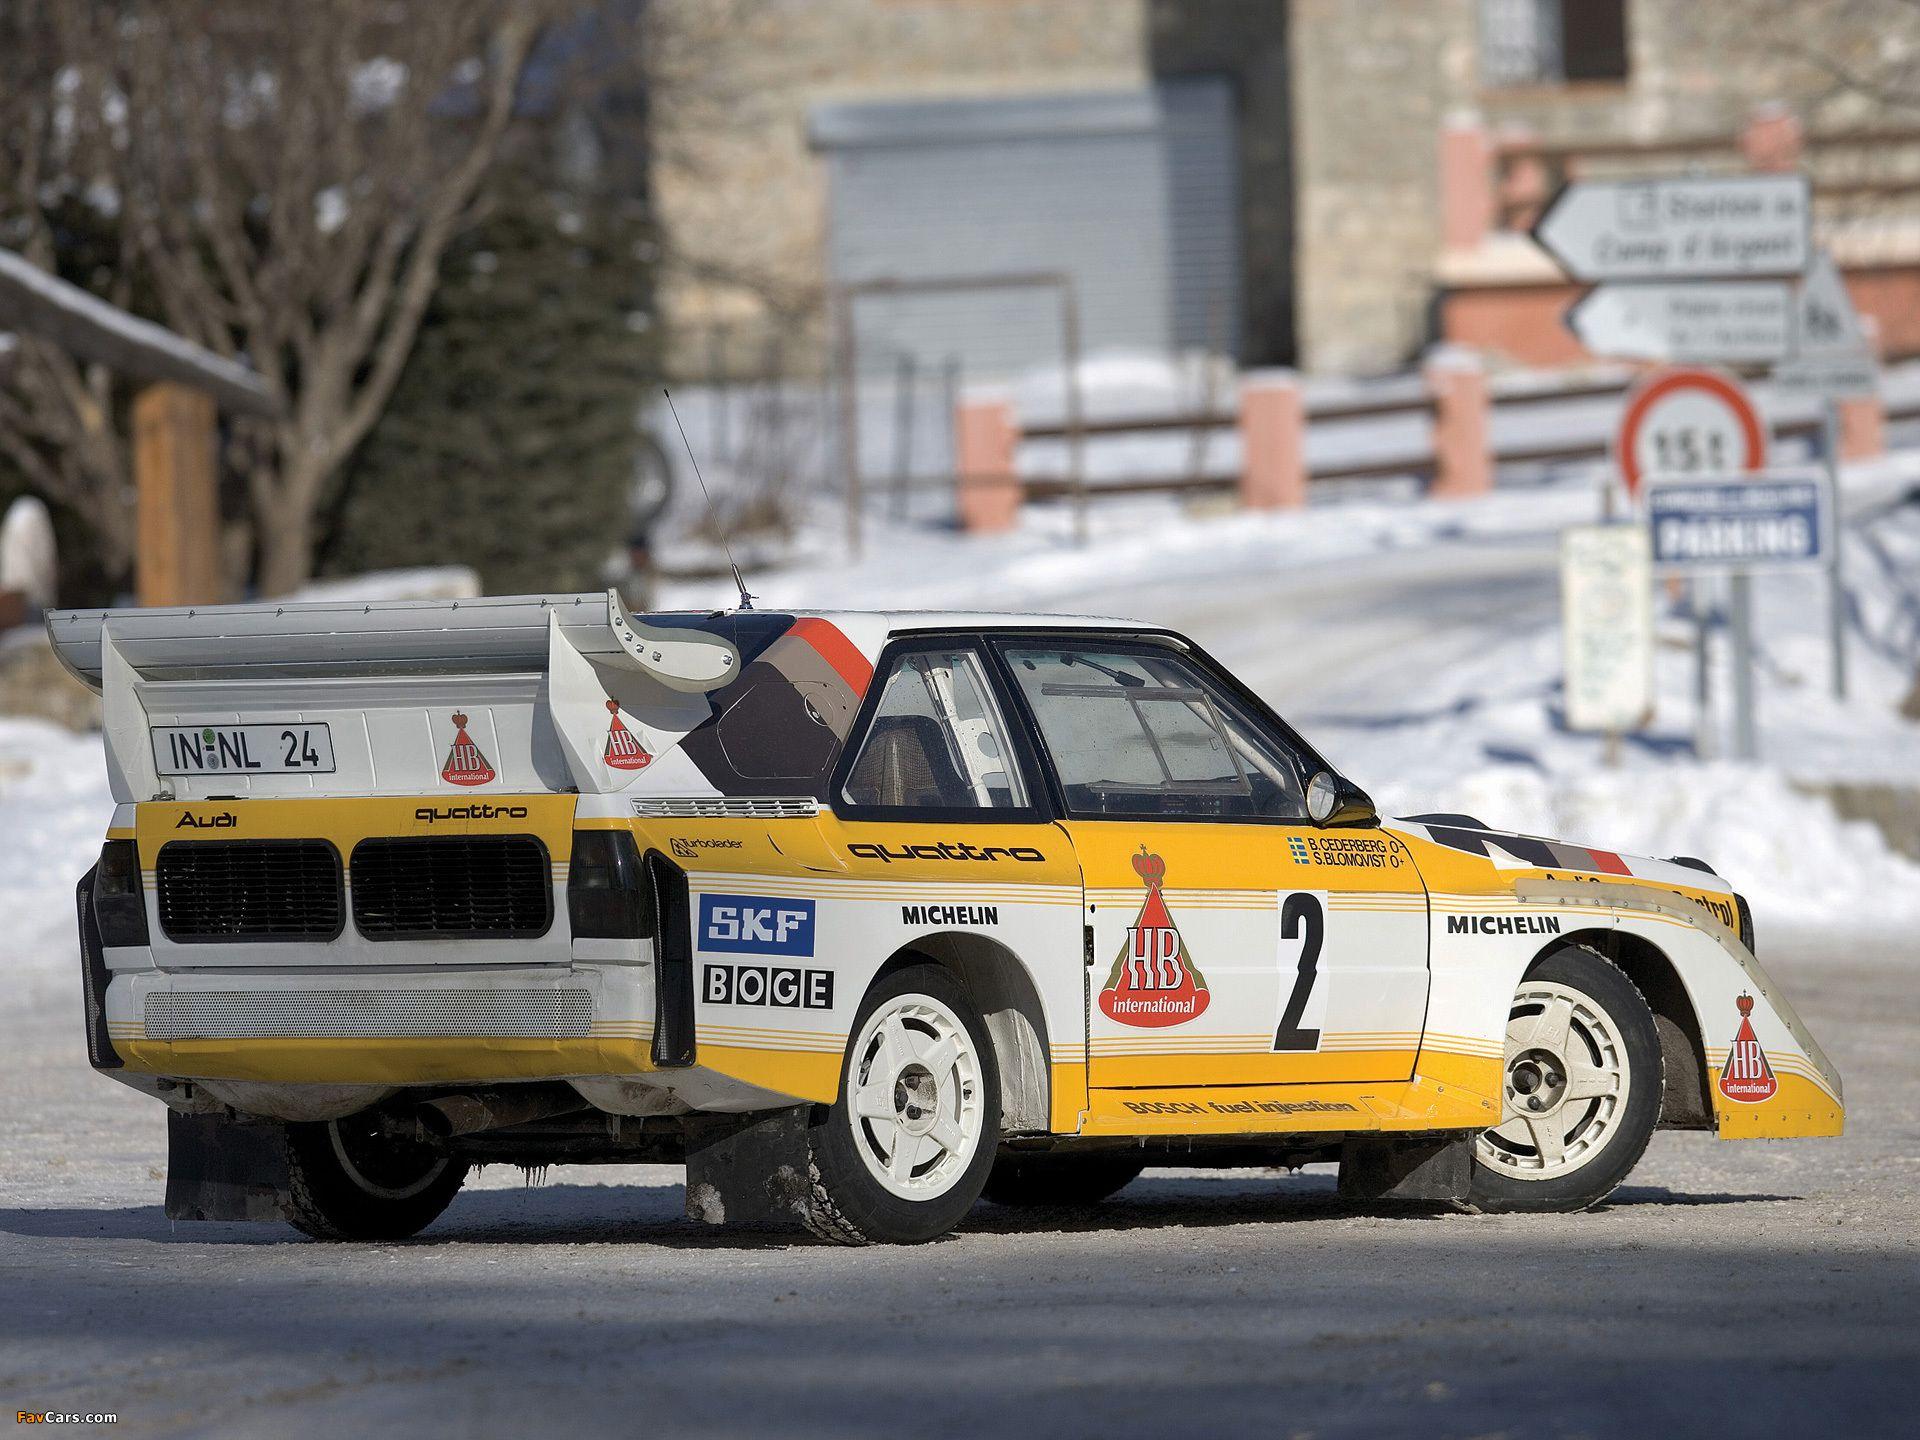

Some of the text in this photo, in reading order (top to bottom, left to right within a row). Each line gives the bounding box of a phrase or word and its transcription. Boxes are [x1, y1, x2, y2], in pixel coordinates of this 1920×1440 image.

[1658, 512, 1811, 557] PARKING
[281, 731, 319, 767] 24
[606, 730, 638, 757] HB
[450, 744, 481, 771] HB
[610, 756, 646, 765] international
[448, 772, 490, 781] international
[175, 811, 238, 828] Audi
[415, 804, 528, 823] quattro
[679, 838, 742, 849] Turbolader
[847, 841, 1046, 863] quattro
[708, 905, 808, 943] SKF
[902, 905, 999, 925] MICHELIN
[1446, 915, 1561, 934] MICHELIN
[1126, 927, 1184, 991] HB
[1273, 892, 1325, 1051] 2
[706, 966, 830, 1007] BOGE
[1113, 995, 1196, 1015] international
[1729, 1039, 1765, 1080] HB
[1726, 1082, 1771, 1094] international
[1123, 1100, 1360, 1115] BOSCH fuel injection
